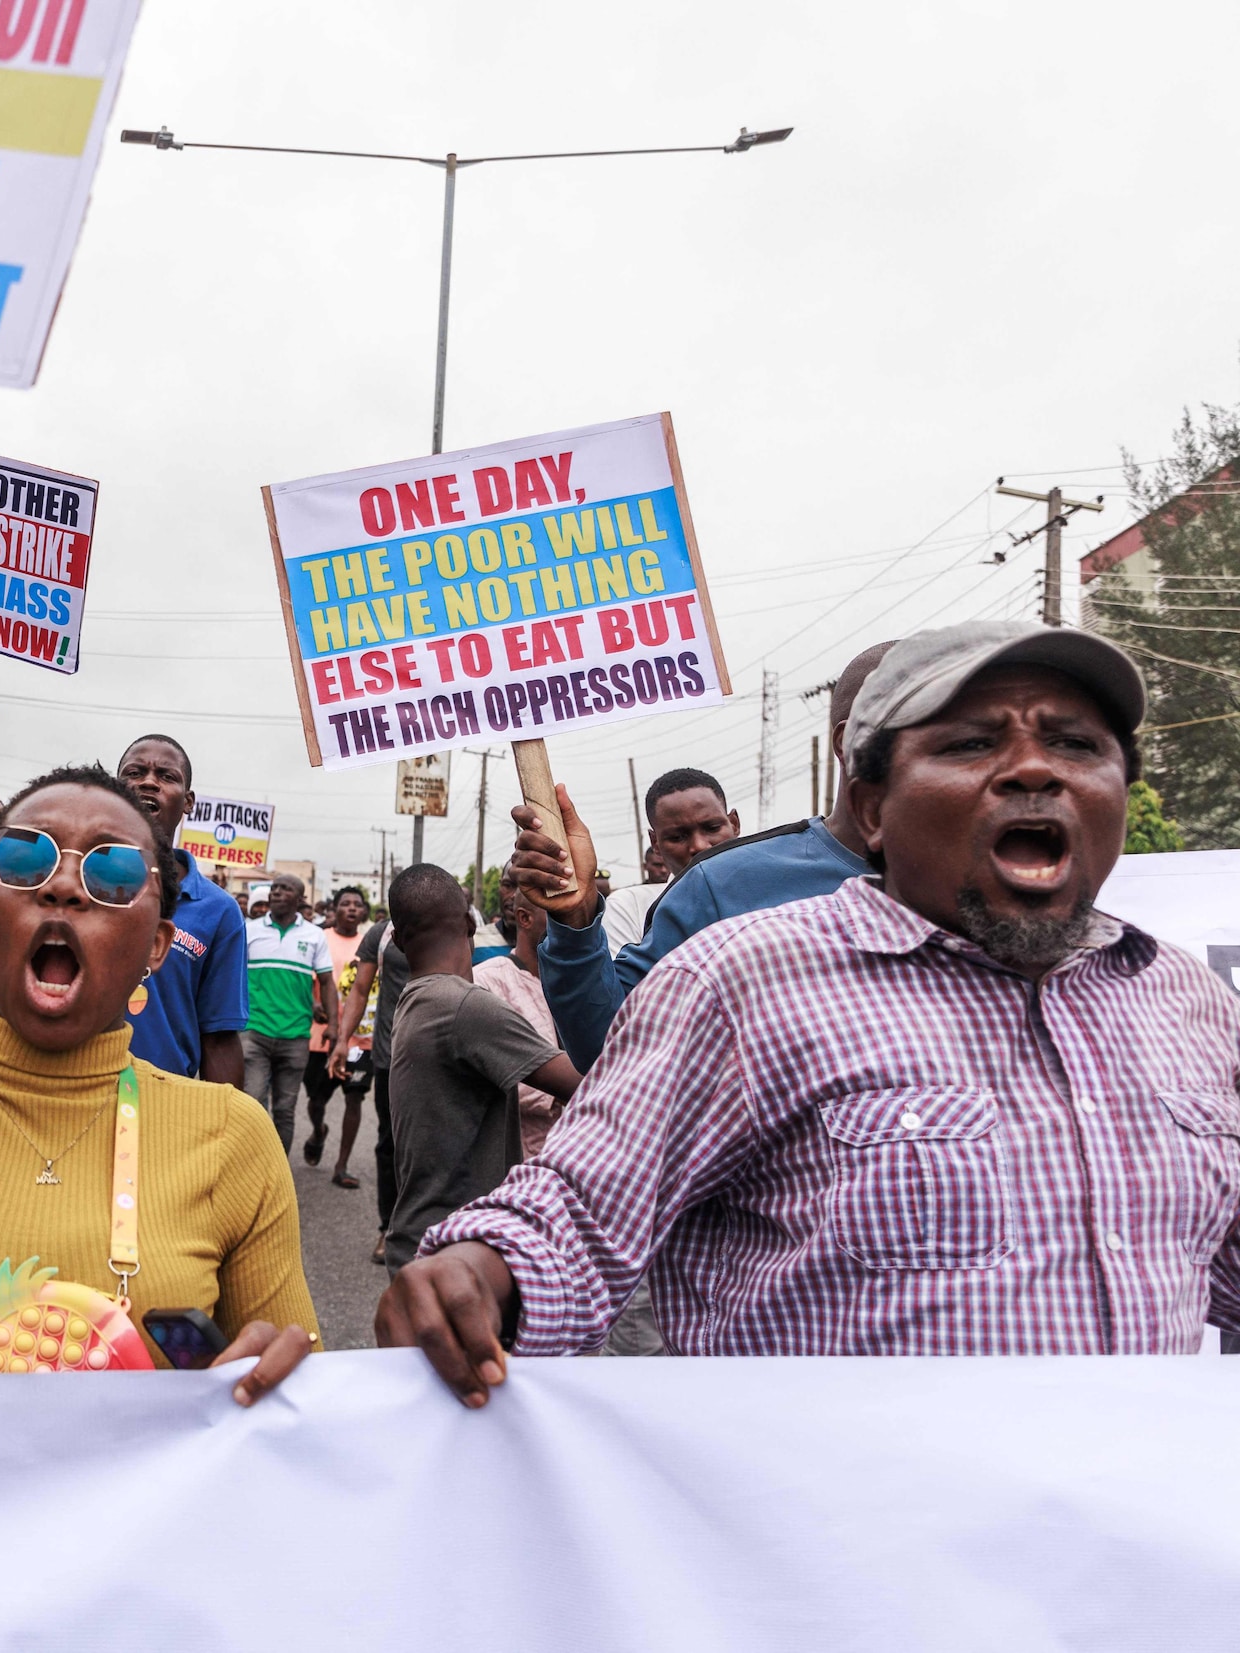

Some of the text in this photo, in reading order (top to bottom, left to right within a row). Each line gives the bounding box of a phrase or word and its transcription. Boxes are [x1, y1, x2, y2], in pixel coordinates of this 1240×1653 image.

[359, 451, 586, 538] ONE DAY,
[301, 496, 668, 603] THE POOR WILL
[309, 548, 666, 655] HAVE NOTHING
[311, 595, 697, 706] ELSE TO EAT BUT
[328, 651, 706, 758] THE RICH OPPRESSORS
[183, 841, 264, 866] FREE PRESS
[214, 803, 269, 833] ATTACKS
[215, 826, 234, 842] ON
[173, 927, 207, 957] NEW
